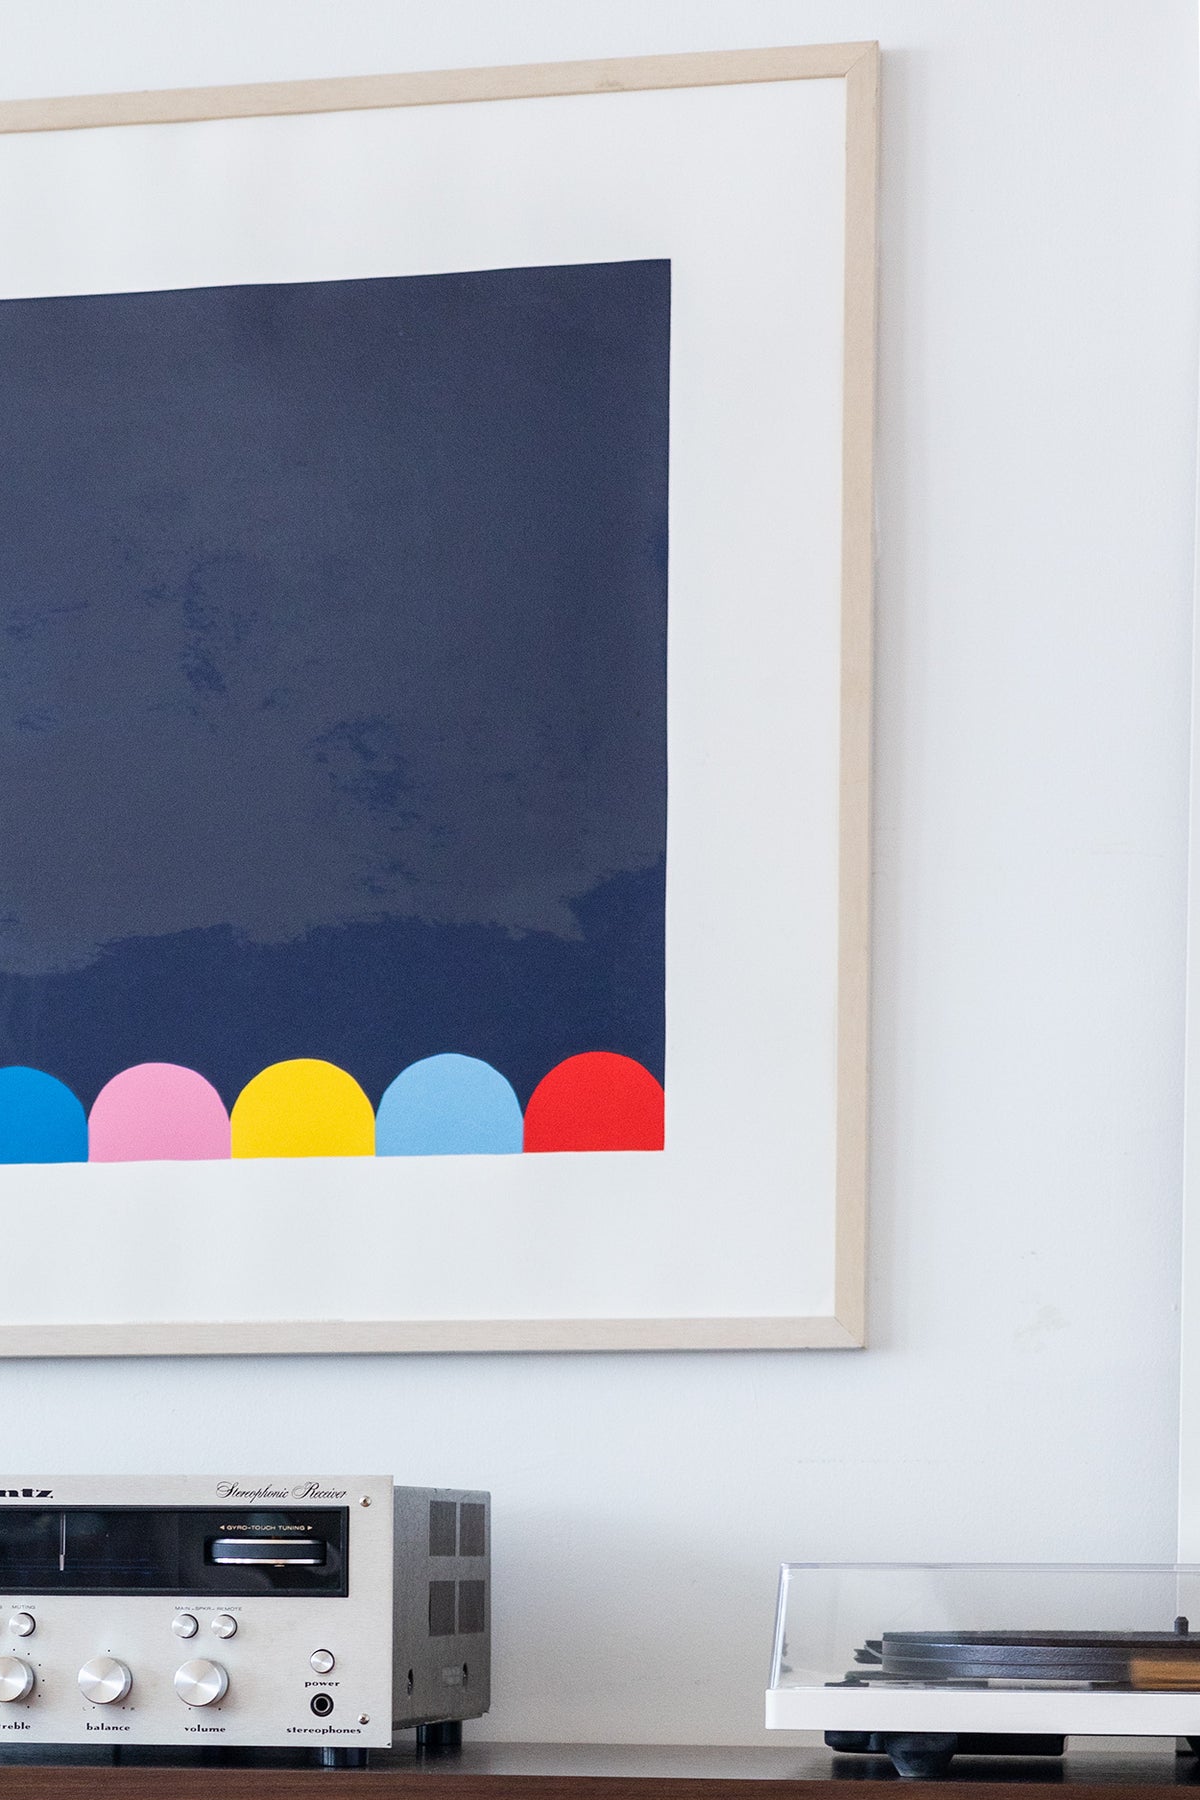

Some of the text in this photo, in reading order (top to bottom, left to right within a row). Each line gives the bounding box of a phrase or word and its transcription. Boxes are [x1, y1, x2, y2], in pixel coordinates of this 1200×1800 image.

[216, 1481, 347, 1503] Stereophonic Receiver
[86, 1722, 131, 1731] balance
[184, 1724, 226, 1733] volume
[286, 1725, 362, 1735] stereophones
